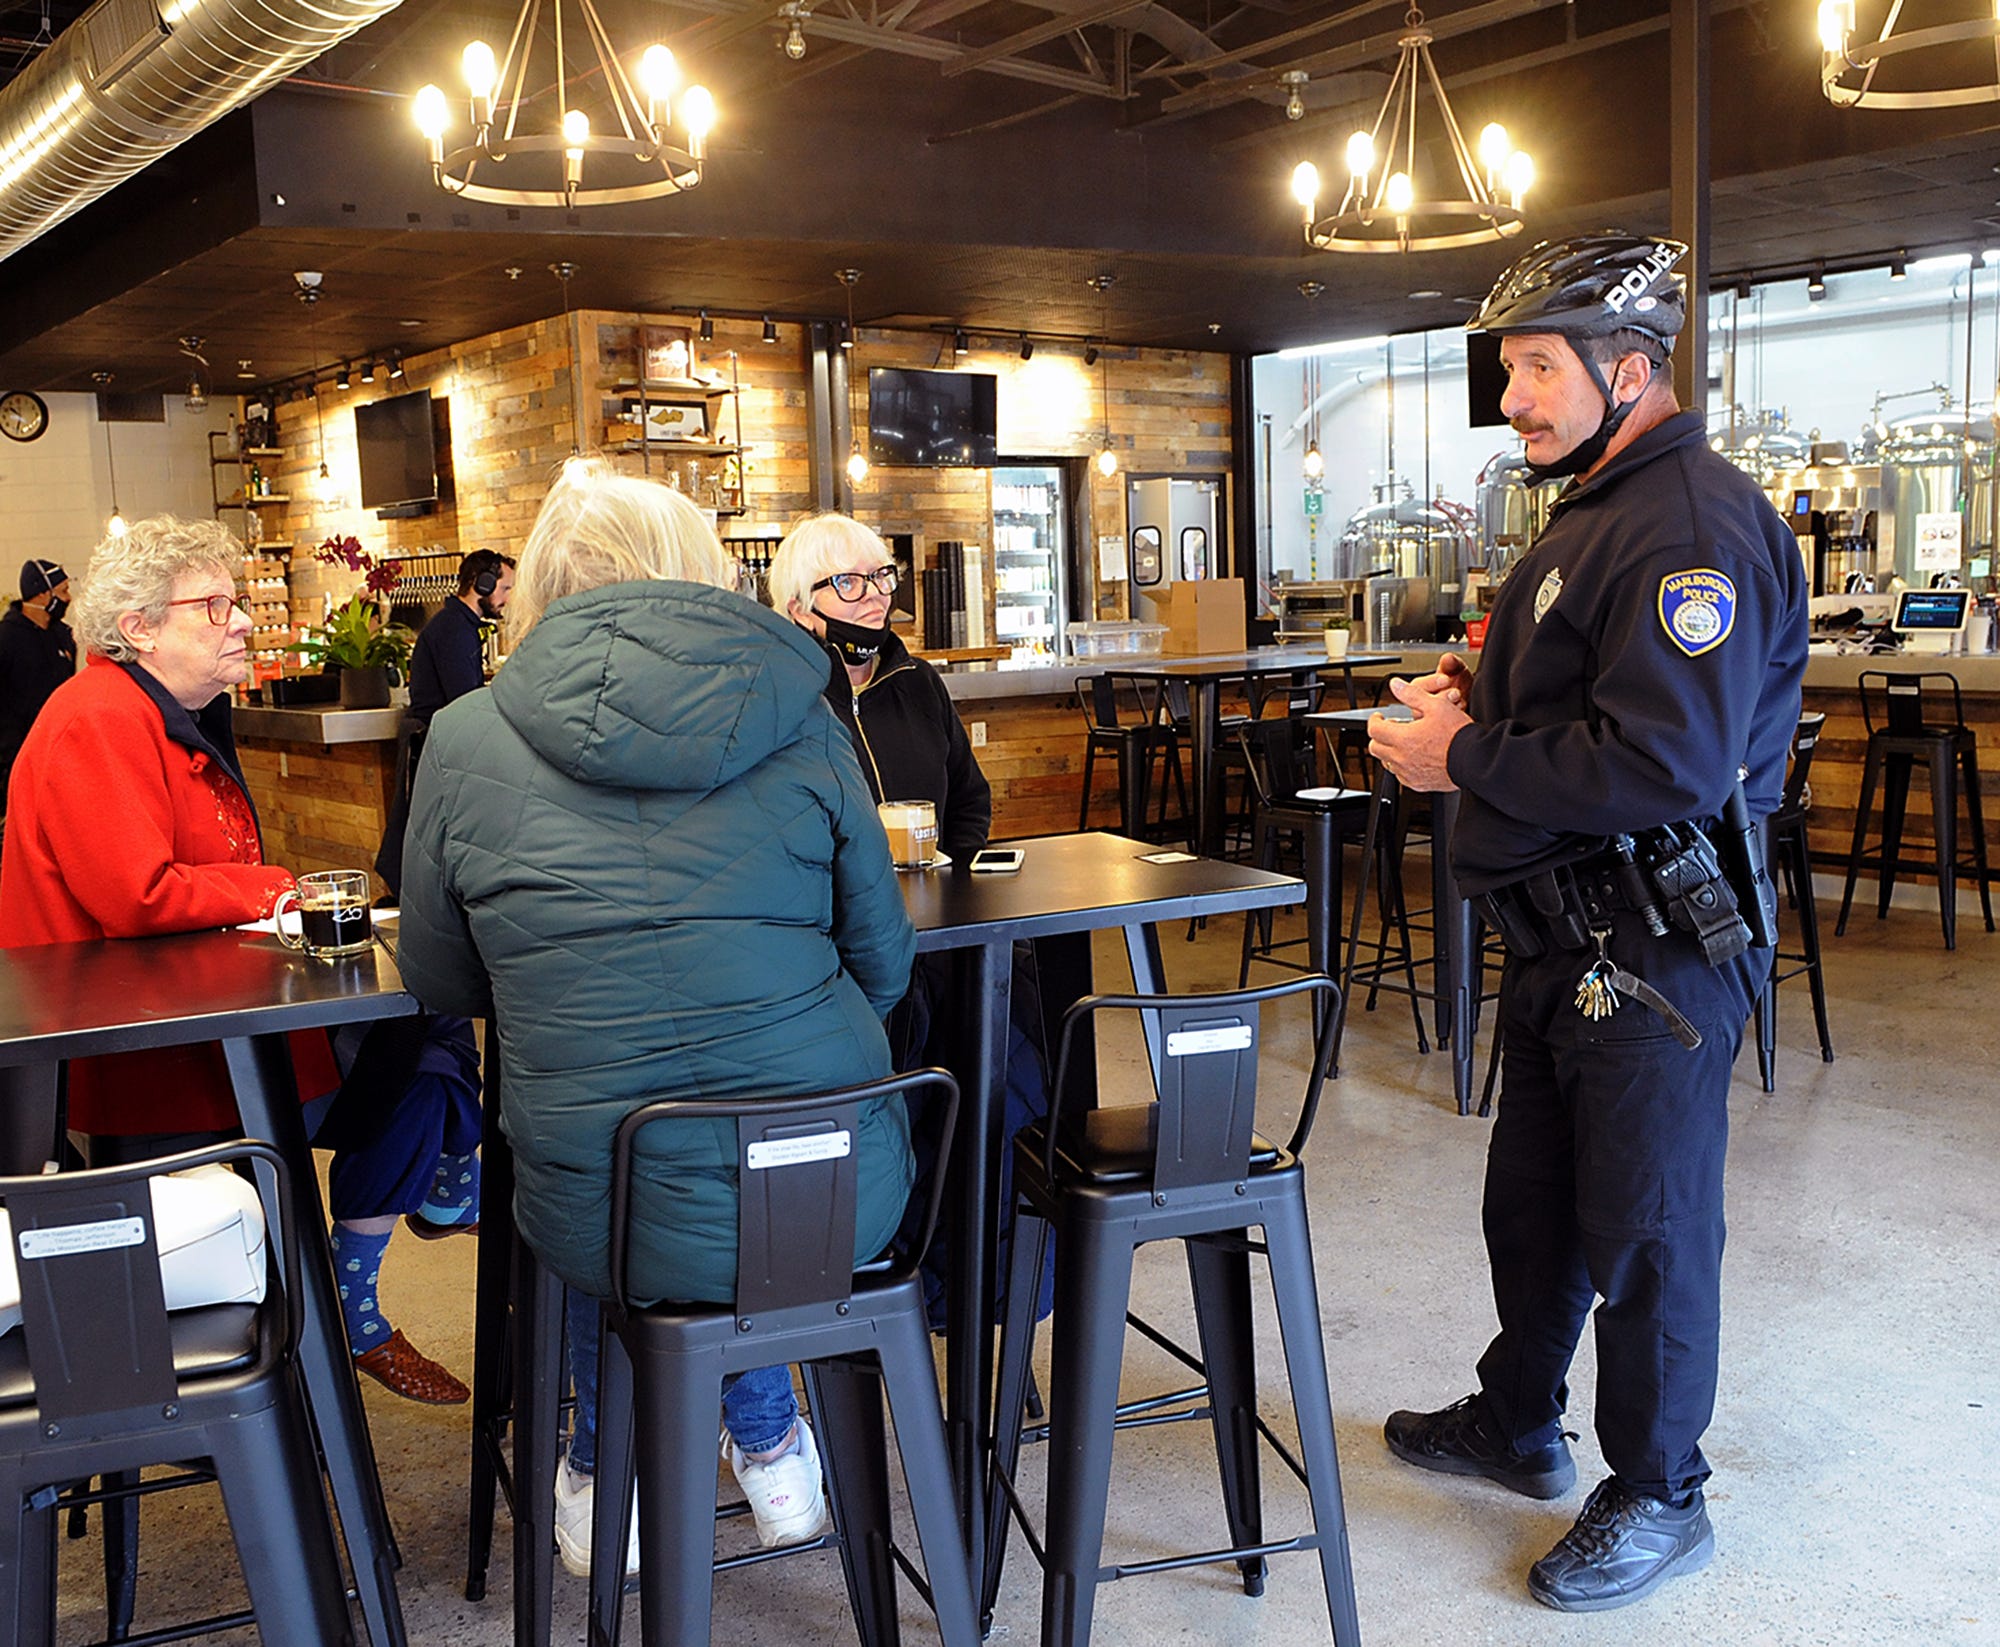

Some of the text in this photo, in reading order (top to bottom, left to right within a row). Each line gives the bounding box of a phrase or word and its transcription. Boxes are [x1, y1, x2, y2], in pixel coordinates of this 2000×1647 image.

[1604, 243, 1678, 313] POLICE
[1667, 575, 1733, 601] MARLBOROUGH
[1683, 588, 1719, 603] POLICE
